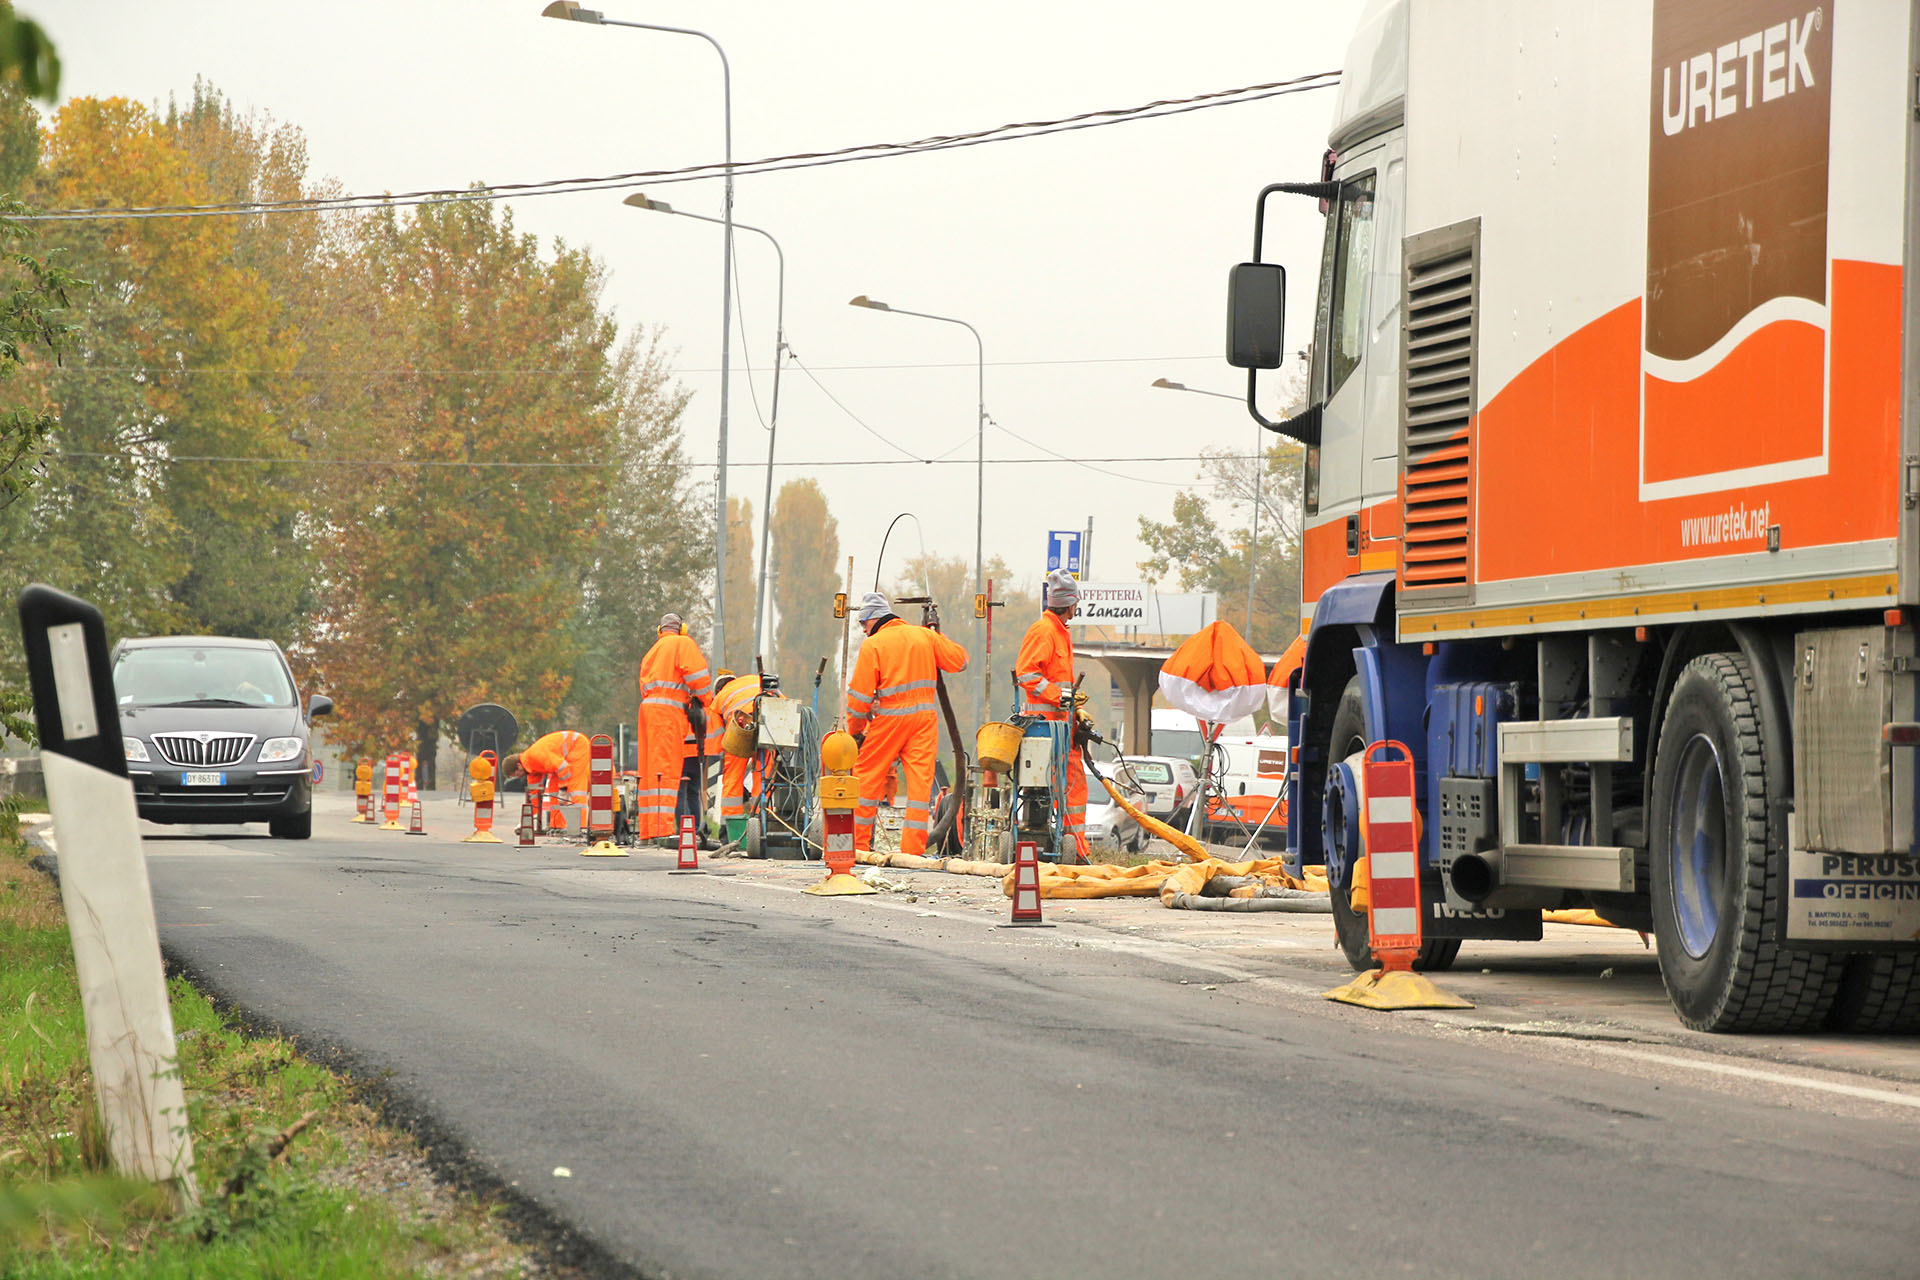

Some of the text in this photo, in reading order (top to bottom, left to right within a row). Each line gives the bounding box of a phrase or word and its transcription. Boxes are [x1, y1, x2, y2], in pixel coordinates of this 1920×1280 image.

[1680, 500, 1770, 548] www.uretek.net
[1077, 589, 1143, 601] AFFETTERIA
[1086, 603, 1143, 618] Zanzara
[1822, 855, 1920, 877] PERUS
